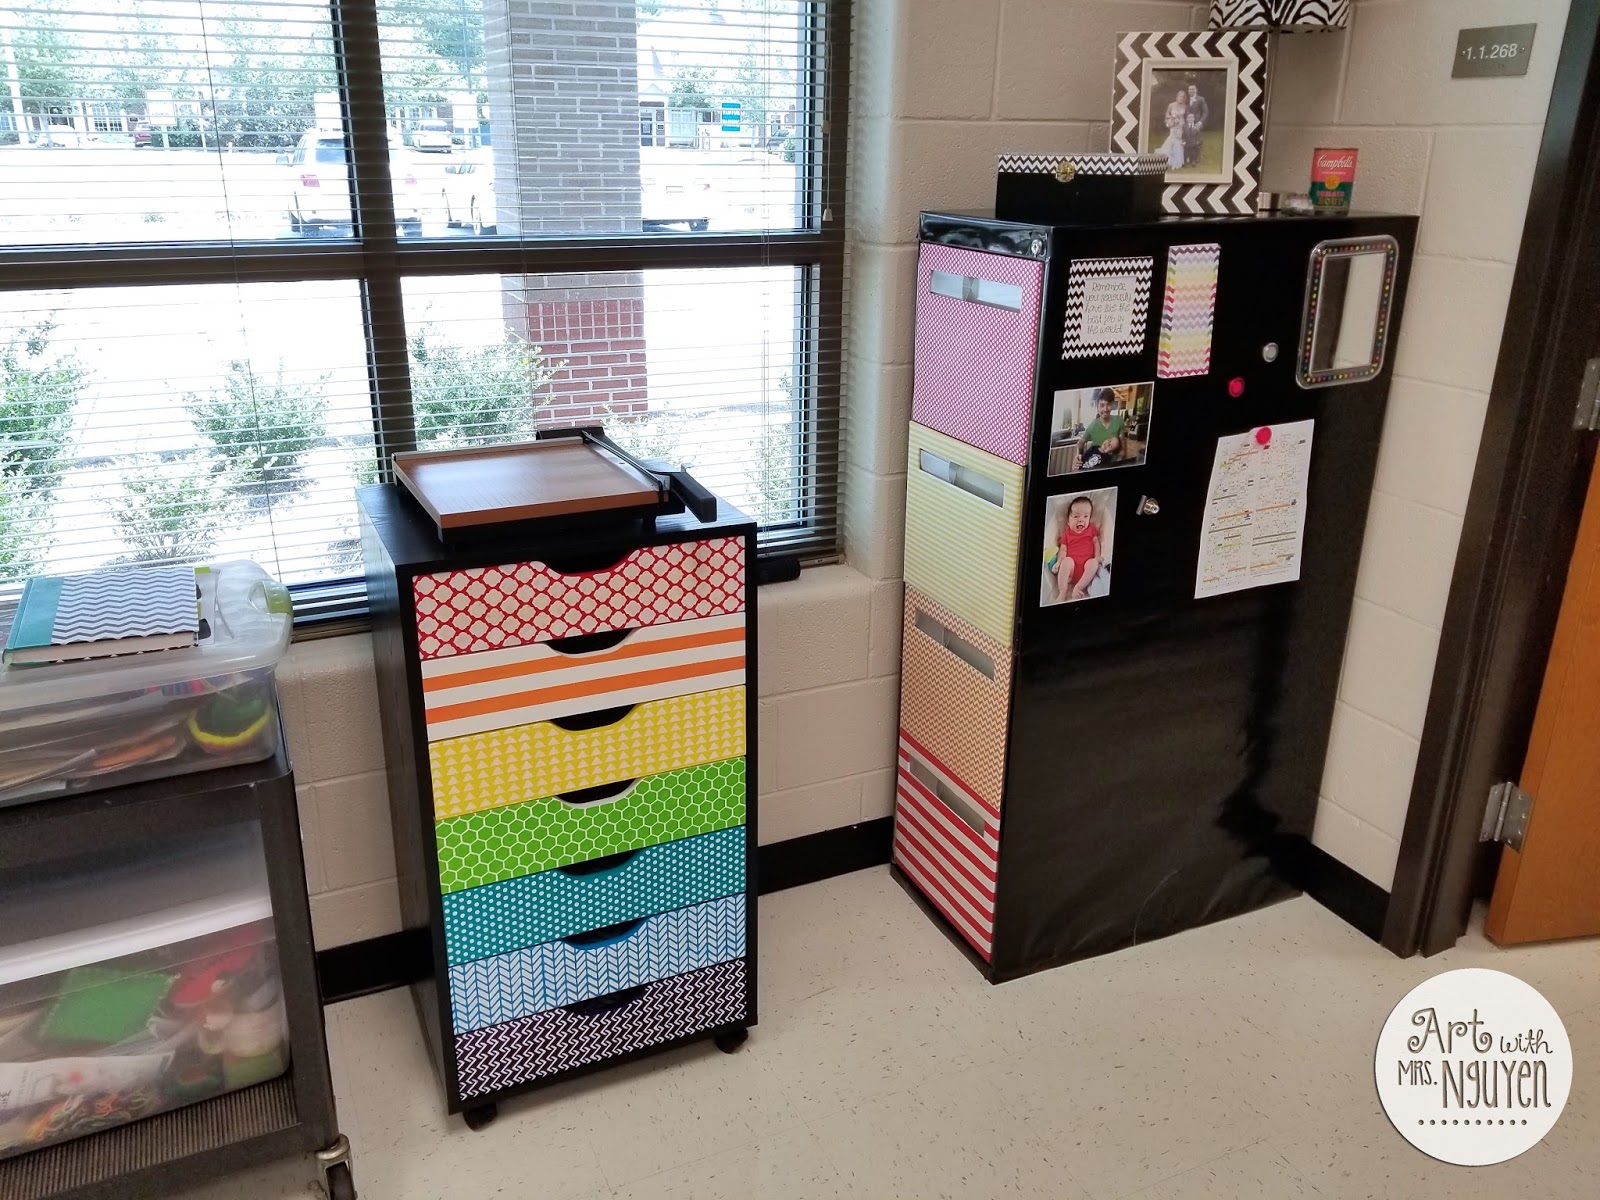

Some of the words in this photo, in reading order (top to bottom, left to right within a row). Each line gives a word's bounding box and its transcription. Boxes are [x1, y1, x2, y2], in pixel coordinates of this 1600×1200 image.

[1467, 43, 1518, 60] 1.1.268
[1119, 302, 1131, 312] the
[1103, 314, 1116, 326] job
[1087, 325, 1099, 334] the
